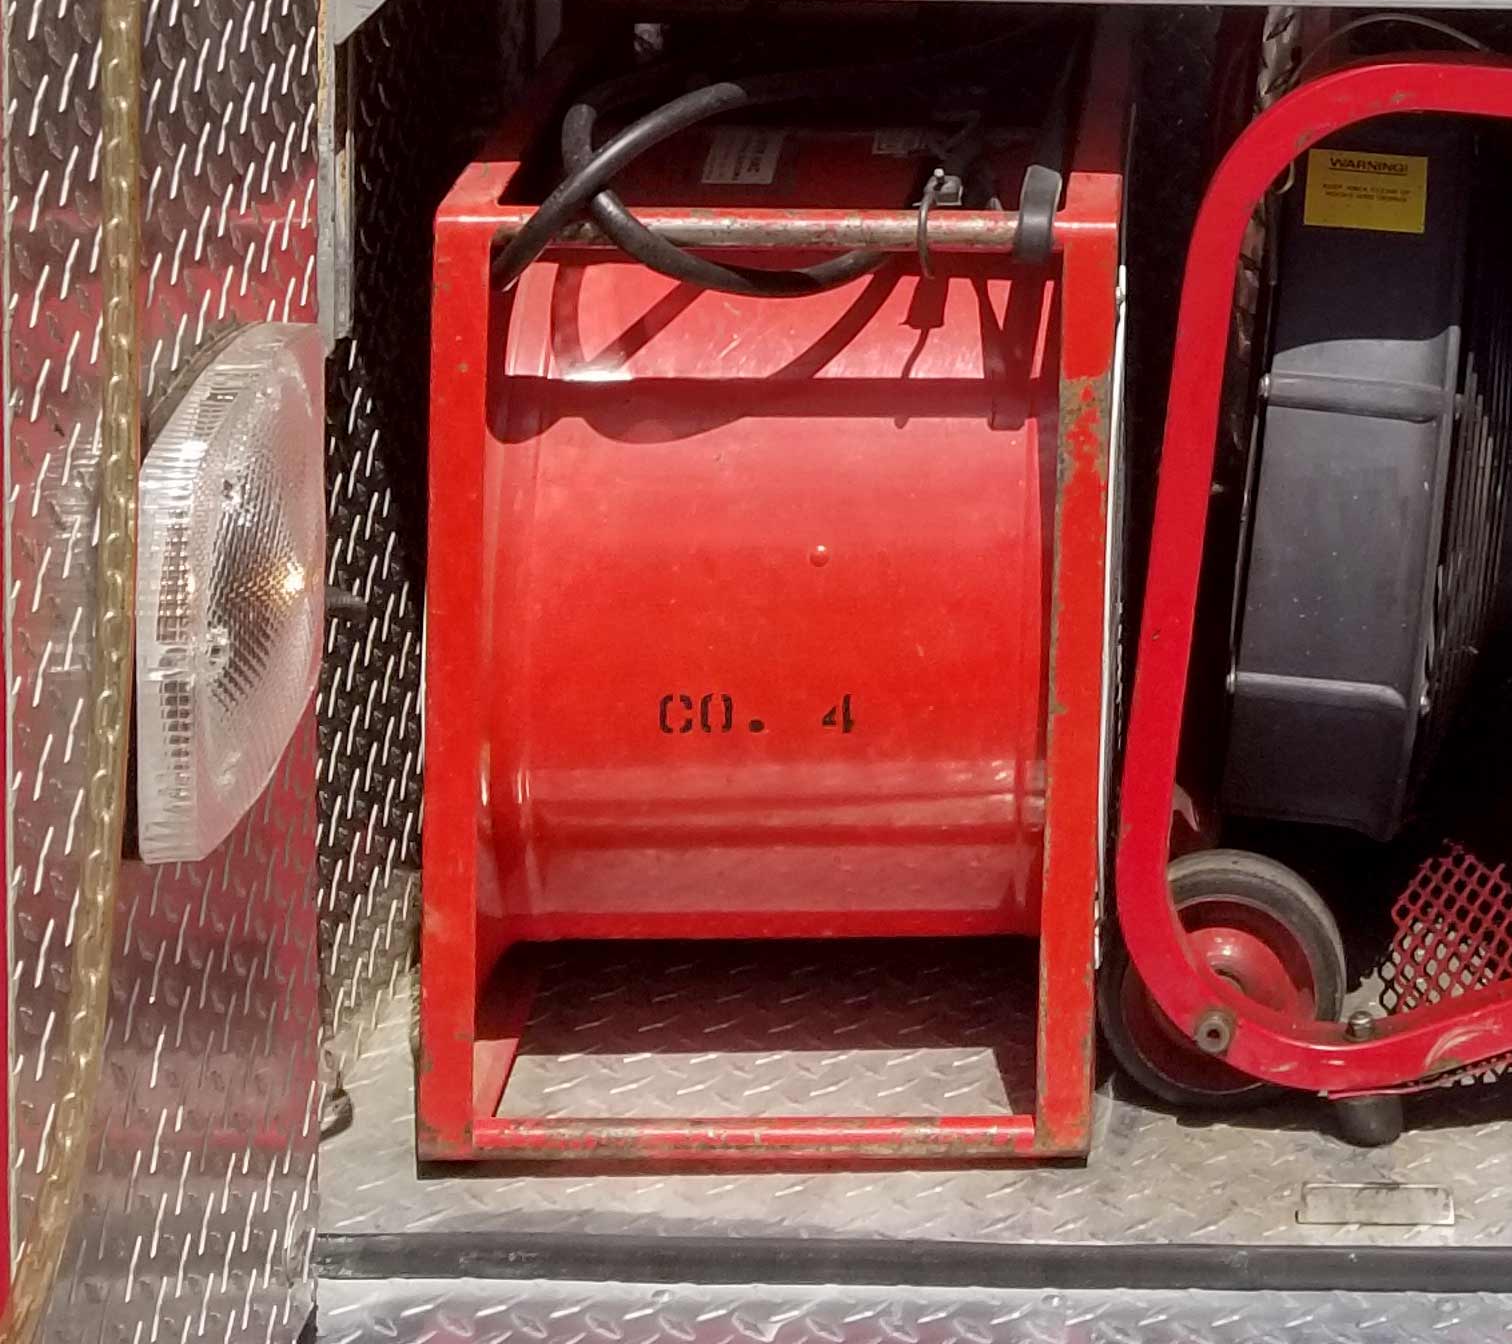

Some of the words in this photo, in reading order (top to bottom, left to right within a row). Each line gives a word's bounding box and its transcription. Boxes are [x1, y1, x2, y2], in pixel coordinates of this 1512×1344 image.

[1329, 156, 1409, 173] WARNING!
[658, 692, 765, 734] CO.
[820, 692, 856, 734] 4
